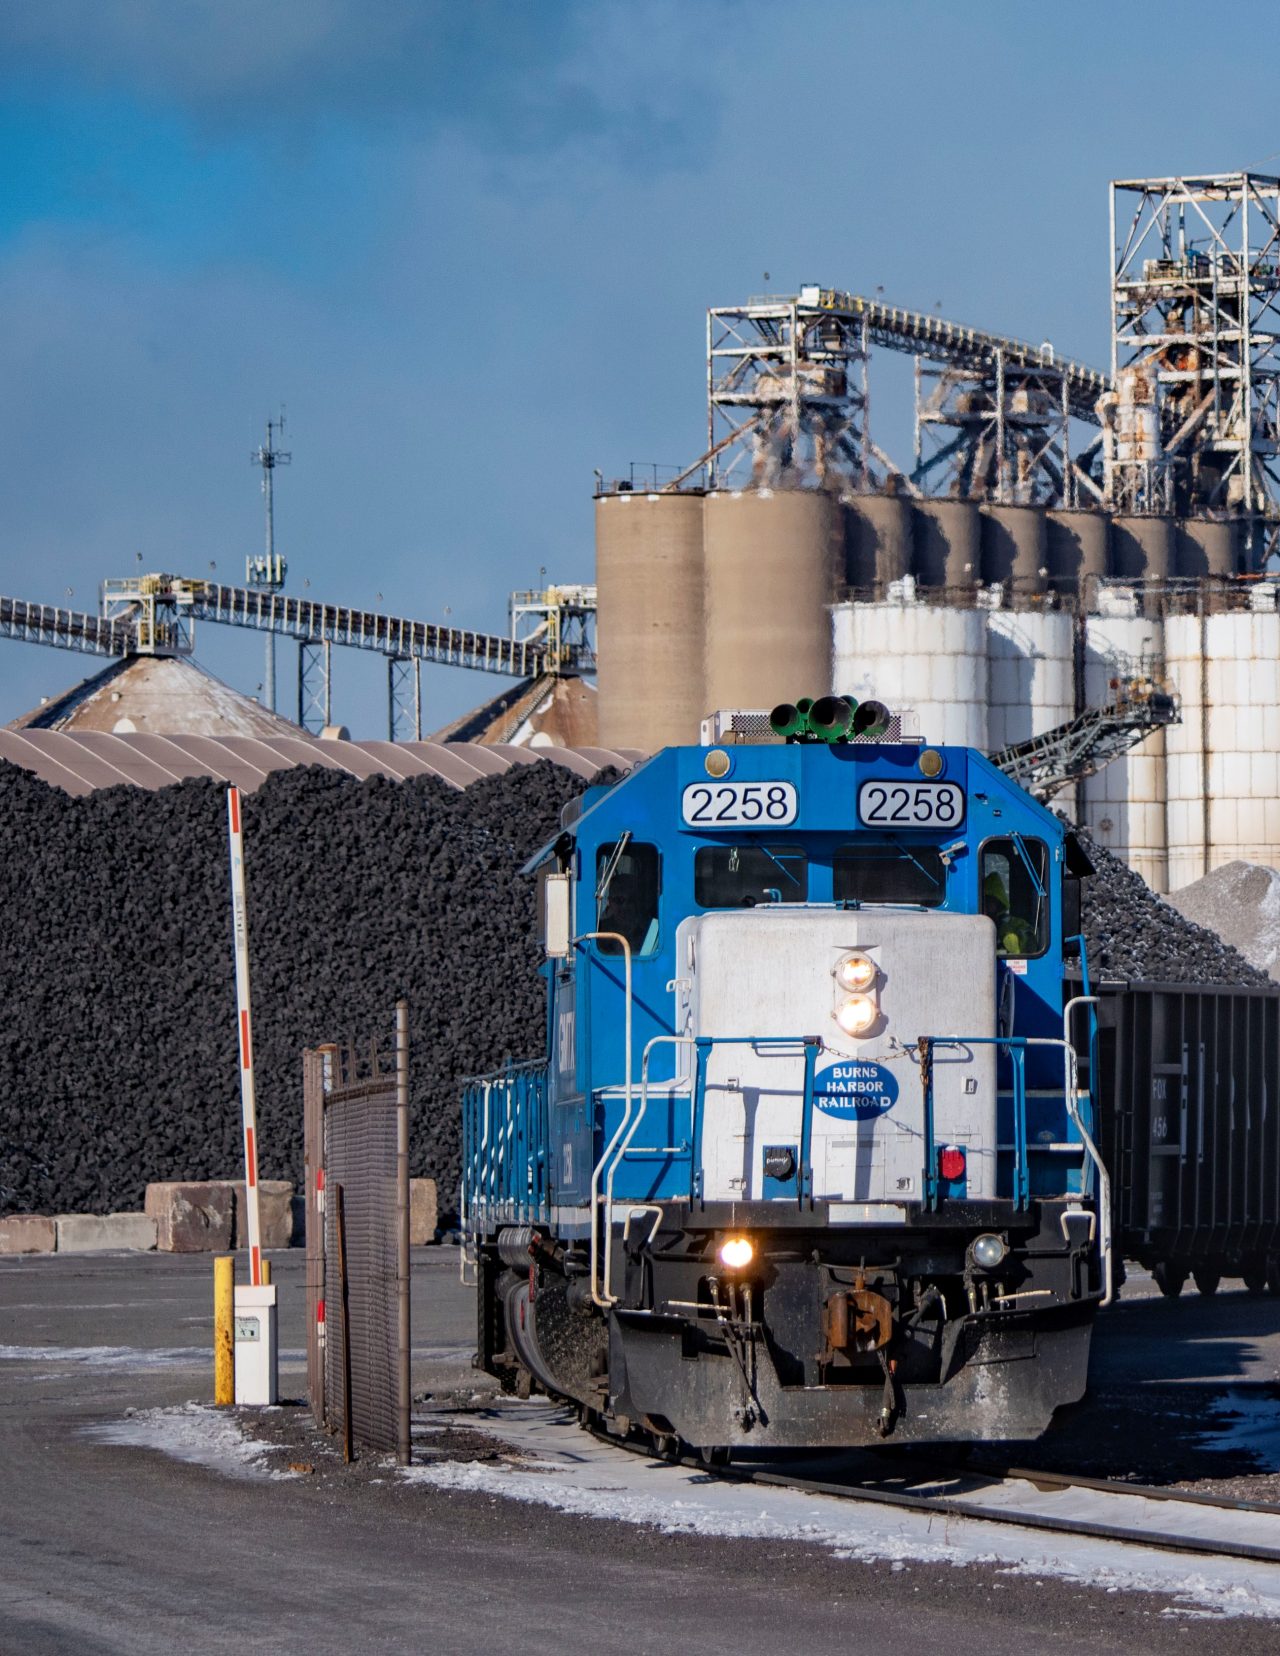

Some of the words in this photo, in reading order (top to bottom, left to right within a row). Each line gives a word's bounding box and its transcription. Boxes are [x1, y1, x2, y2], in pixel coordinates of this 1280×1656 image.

[690, 785, 789, 822] 2258
[867, 786, 956, 822] 2258
[832, 1066, 878, 1079] BURNS
[826, 1080, 884, 1093] HARBOR
[818, 1095, 892, 1108] RAILROAD
